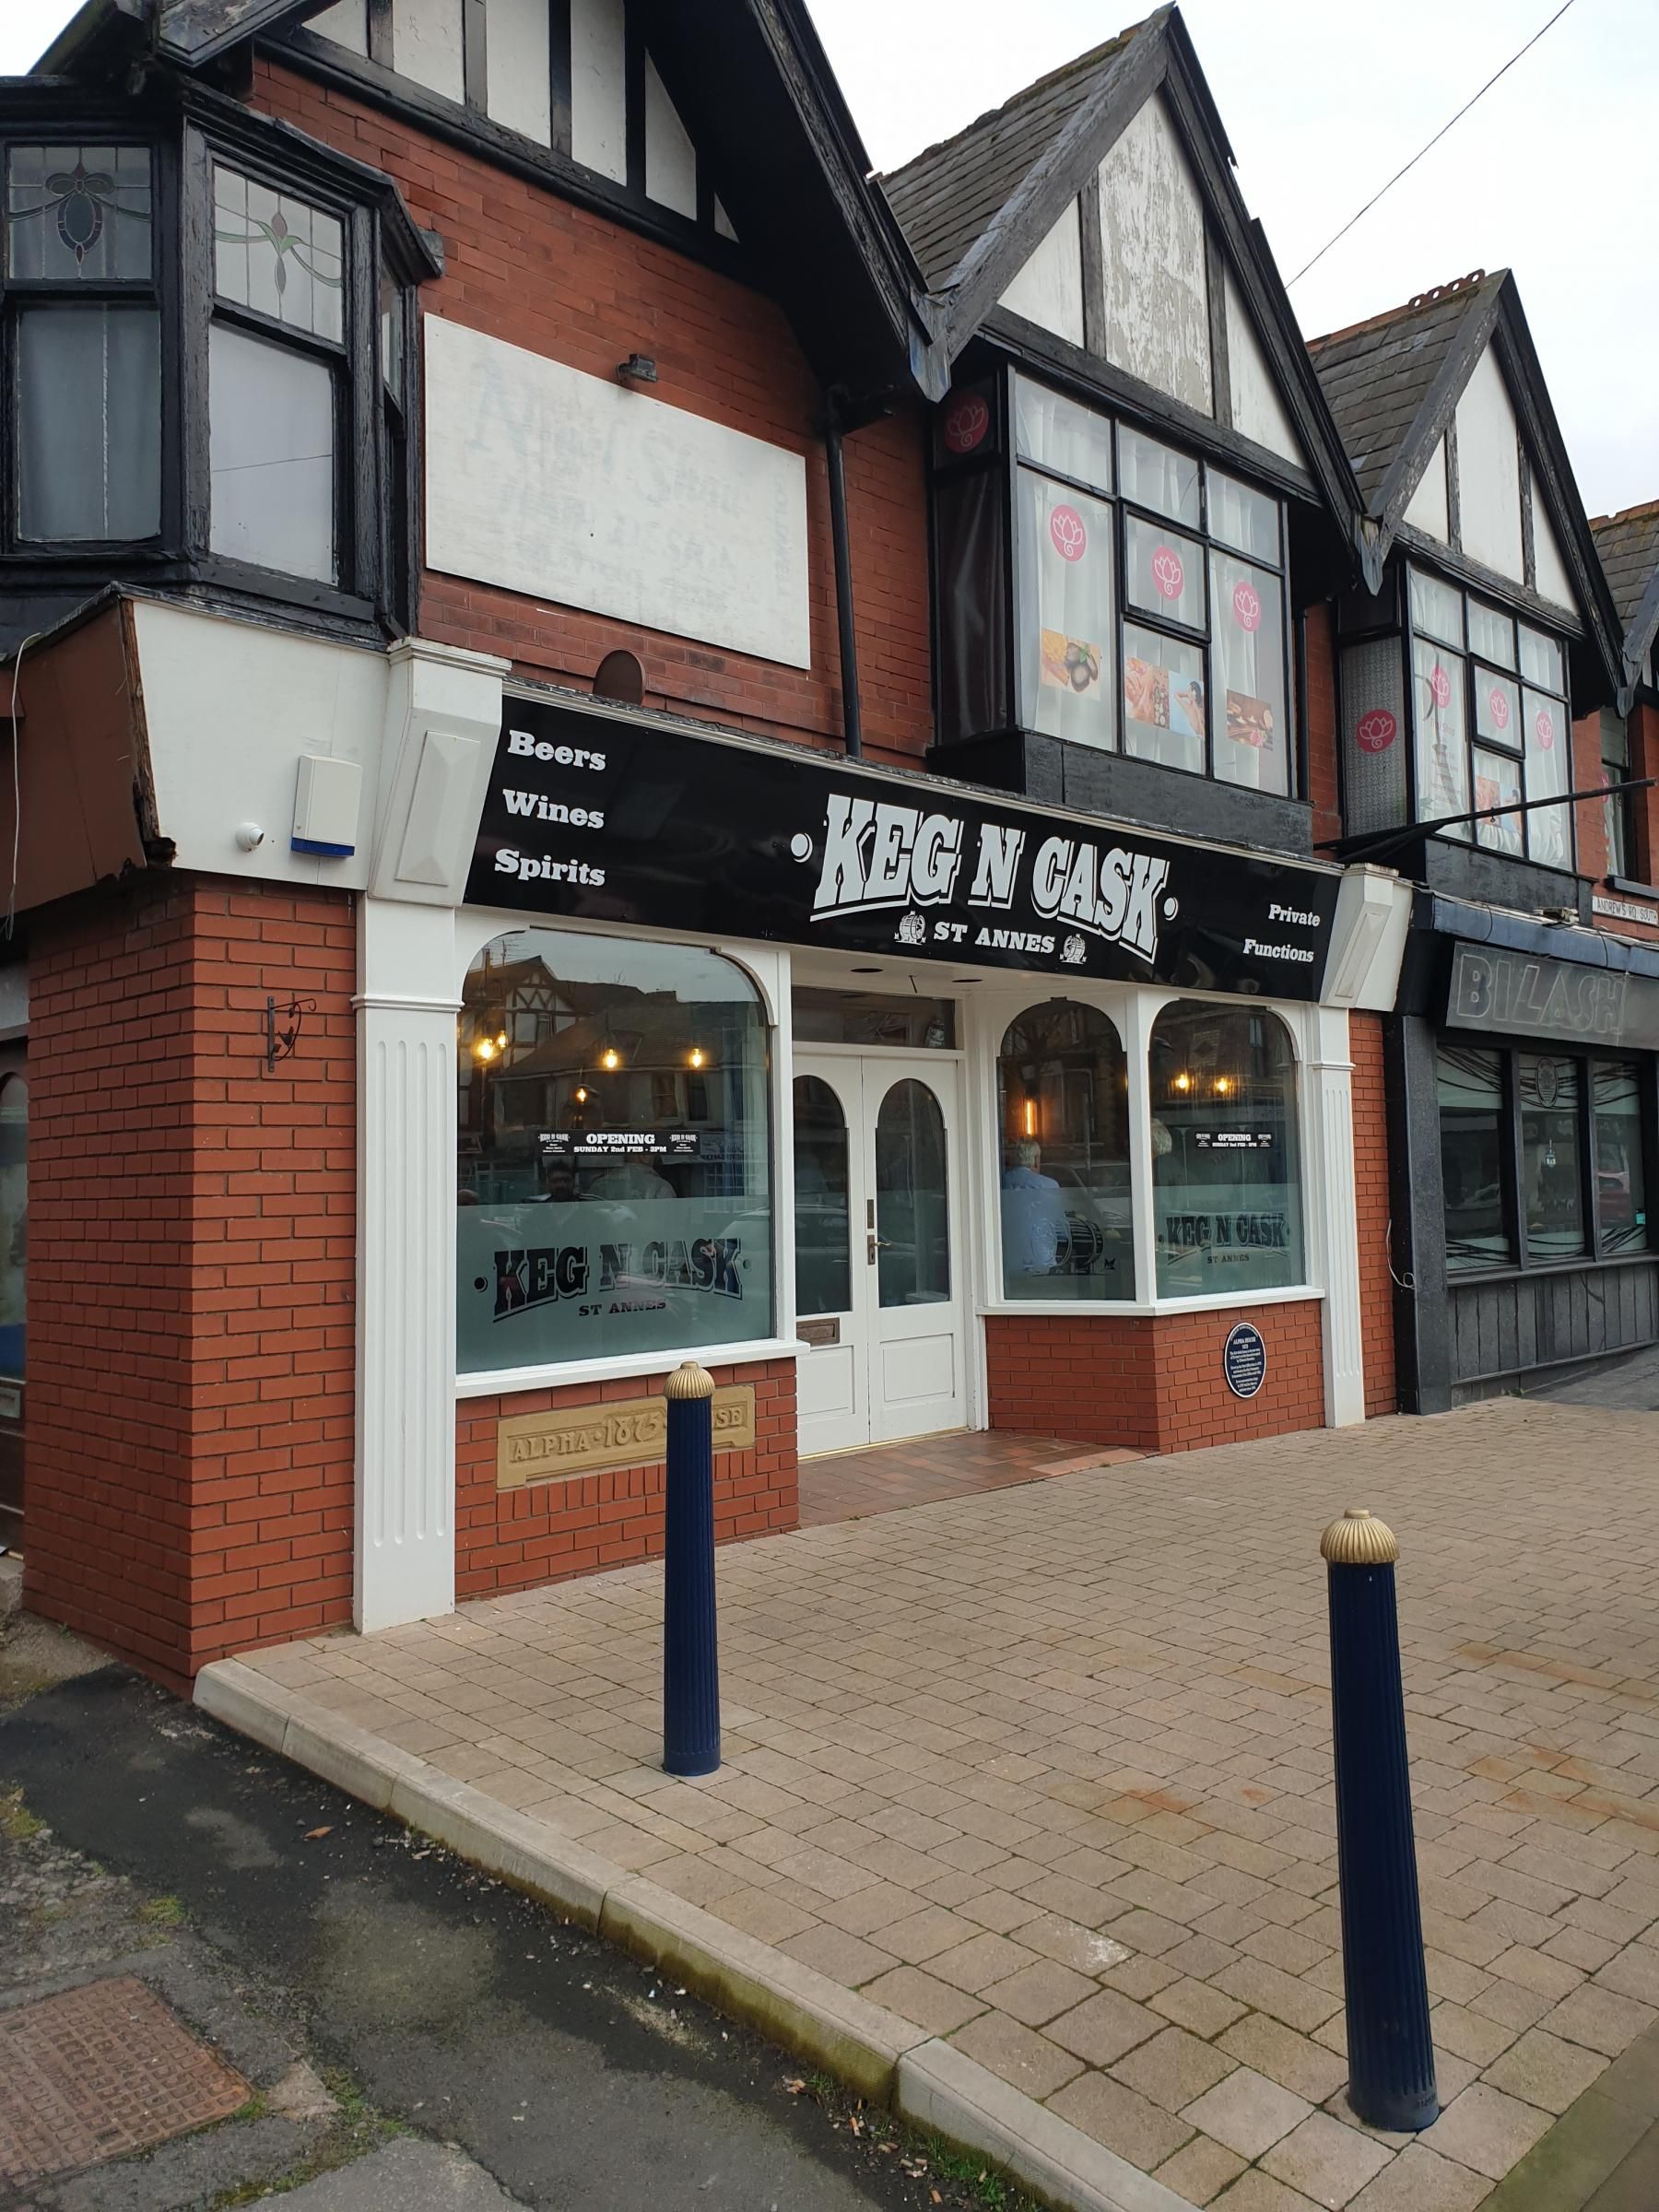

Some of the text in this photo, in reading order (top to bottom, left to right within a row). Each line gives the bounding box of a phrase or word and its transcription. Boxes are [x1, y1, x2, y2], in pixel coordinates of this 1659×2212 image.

[508, 729, 606, 771] Beers
[502, 789, 605, 829] Wines
[494, 848, 606, 887] Spirits
[810, 794, 1171, 964] KEG N CASK
[1268, 903, 1321, 927] Private
[933, 921, 1055, 954] ST ANNES
[1242, 938, 1314, 962] Functions
[1456, 953, 1626, 1035] BILASH
[586, 1133, 655, 1145] OPENING
[1218, 1133, 1252, 1142] OPENING
[1165, 1213, 1287, 1265] KEG N CASK
[1221, 1253, 1250, 1263] ANNES
[493, 1237, 743, 1323] KEG N CASK
[578, 1299, 666, 1316] ST ANNES
[510, 1410, 667, 1463] ALPHA 1875
